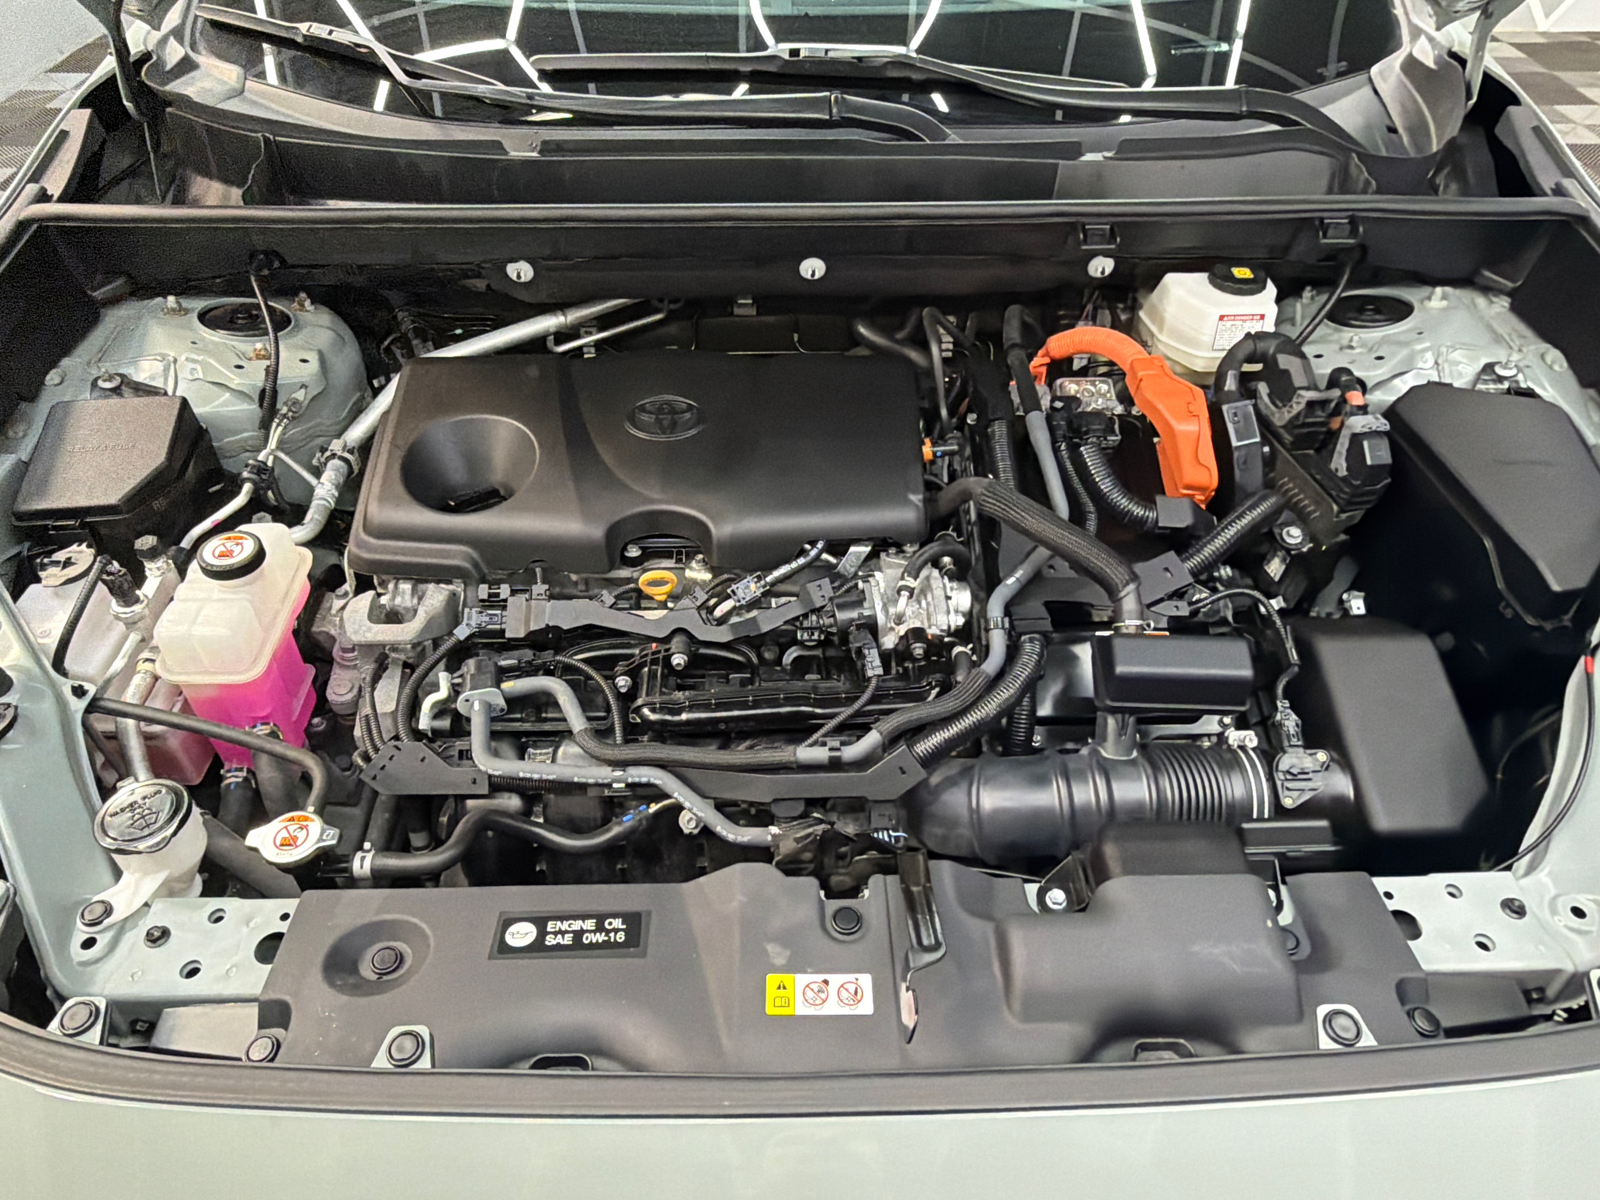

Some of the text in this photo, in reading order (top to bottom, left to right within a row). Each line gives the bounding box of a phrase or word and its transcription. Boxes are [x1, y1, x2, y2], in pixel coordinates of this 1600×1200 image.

[546, 918, 626, 932] ENGINE OIL
[545, 932, 625, 945] SAE 0W-16
